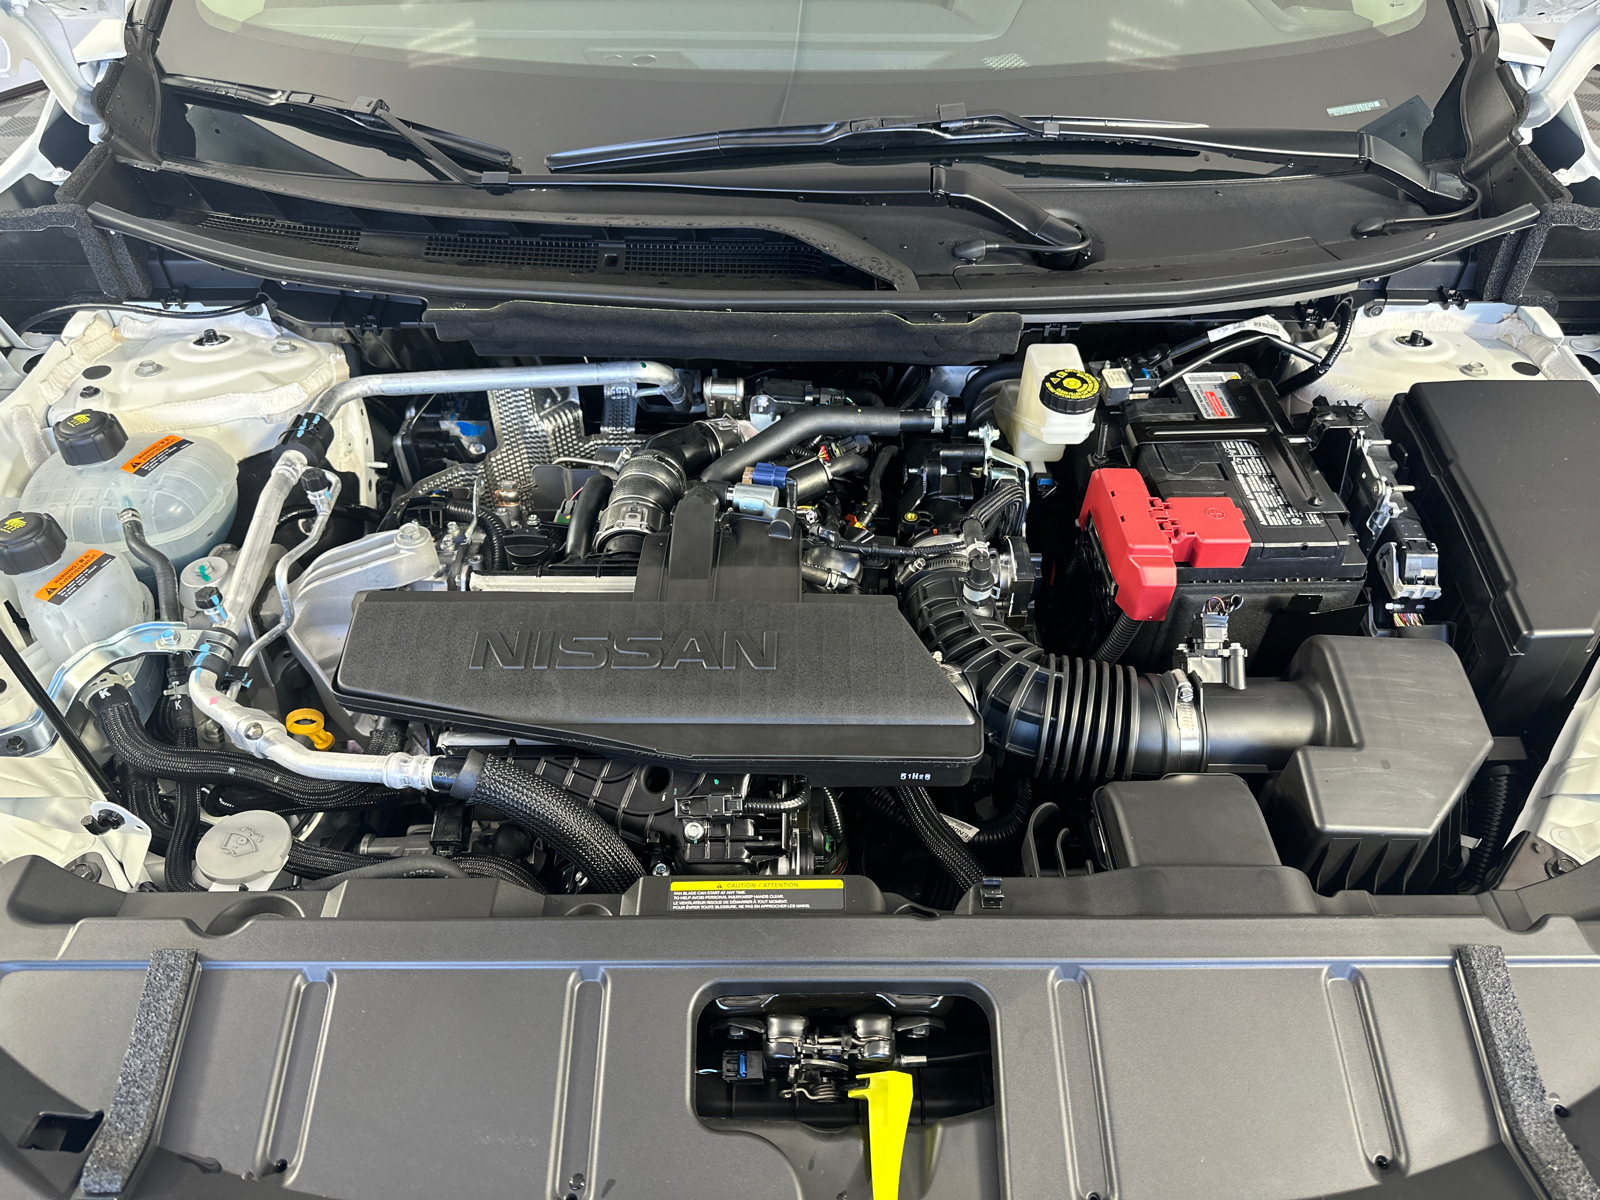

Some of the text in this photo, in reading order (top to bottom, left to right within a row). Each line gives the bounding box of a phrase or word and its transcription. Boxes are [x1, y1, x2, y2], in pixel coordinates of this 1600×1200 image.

[54, 565, 77, 584] WARNING
[59, 554, 98, 586] AVERTISSEMENT
[469, 630, 777, 670] NISSAN
